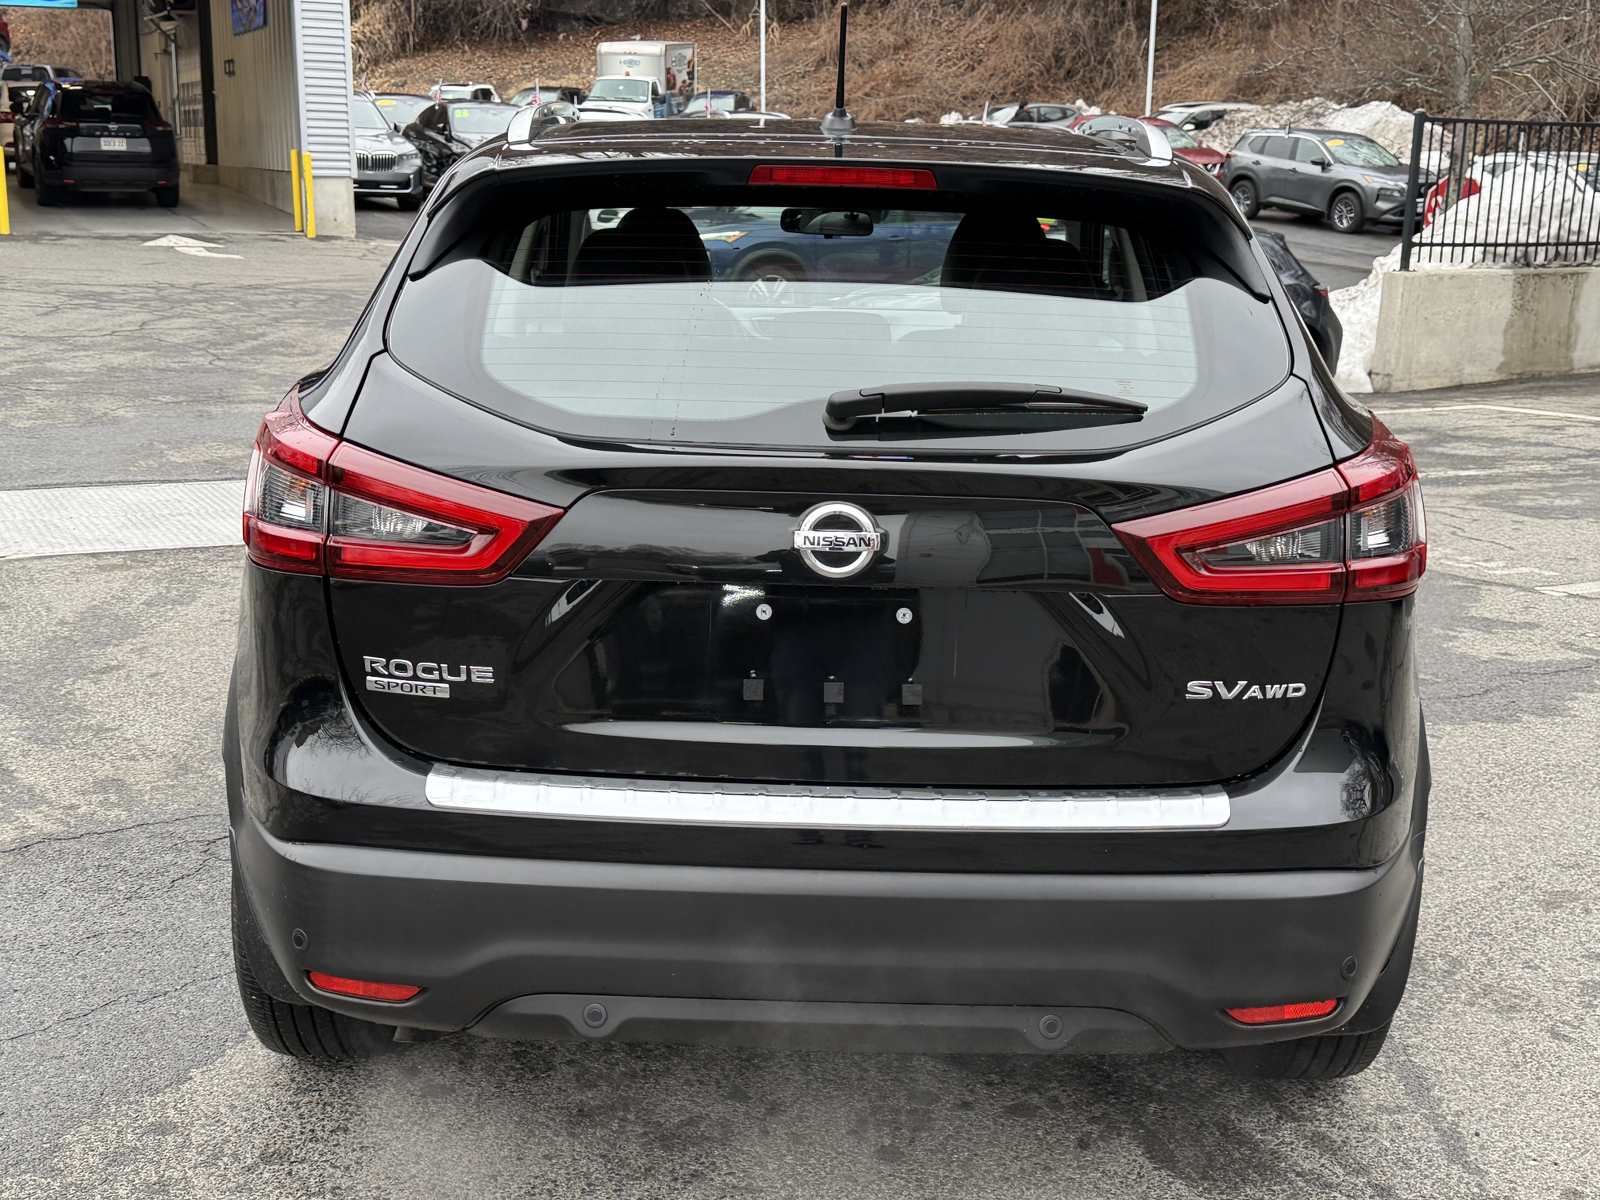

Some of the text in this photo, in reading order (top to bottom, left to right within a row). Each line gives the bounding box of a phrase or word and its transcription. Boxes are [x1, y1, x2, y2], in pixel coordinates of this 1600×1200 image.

[803, 536, 871, 548] NISSAN
[363, 655, 495, 683] ROGUE
[374, 680, 441, 695] SPORT
